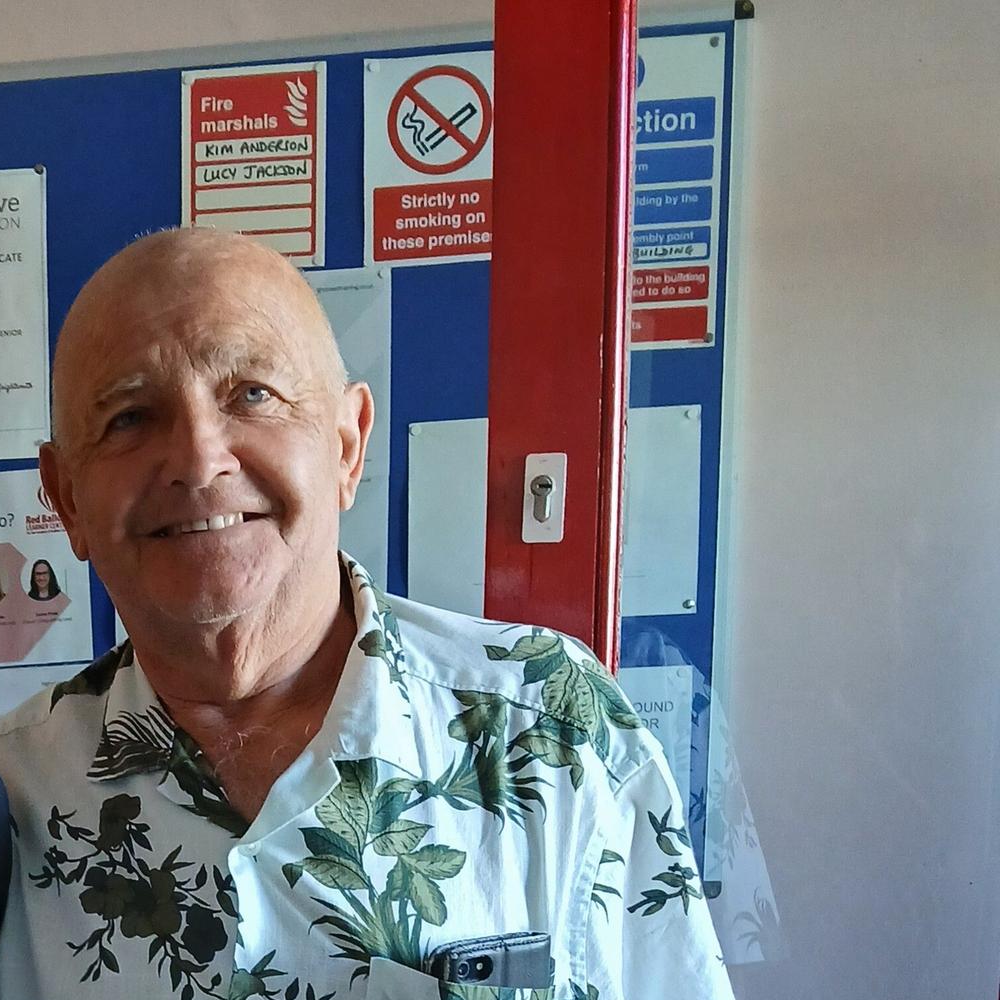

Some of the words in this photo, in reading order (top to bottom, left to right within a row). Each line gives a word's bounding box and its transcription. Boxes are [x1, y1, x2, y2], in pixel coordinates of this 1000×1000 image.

[201, 97, 233, 113] Fire
[201, 113, 278, 133] marshals
[205, 142, 233, 158] KIM
[240, 136, 308, 155] ANDERSON
[204, 167, 237, 182] LUCY
[243, 160, 307, 180] JACKSON
[401, 192, 455, 209] Strictly
[460, 191, 480, 205] no
[665, 194, 678, 205] by
[681, 192, 698, 203] the
[395, 212, 461, 230] smoking
[466, 211, 485, 225] on
[382, 235, 424, 251] these
[667, 231, 694, 242] point
[633, 245, 694, 259] BUILDING
[645, 275, 662, 284] the
[664, 272, 705, 284] building
[648, 286, 659, 296] to
[662, 285, 676, 295] do
[678, 286, 691, 294] so
[26, 515, 40, 524] Red
